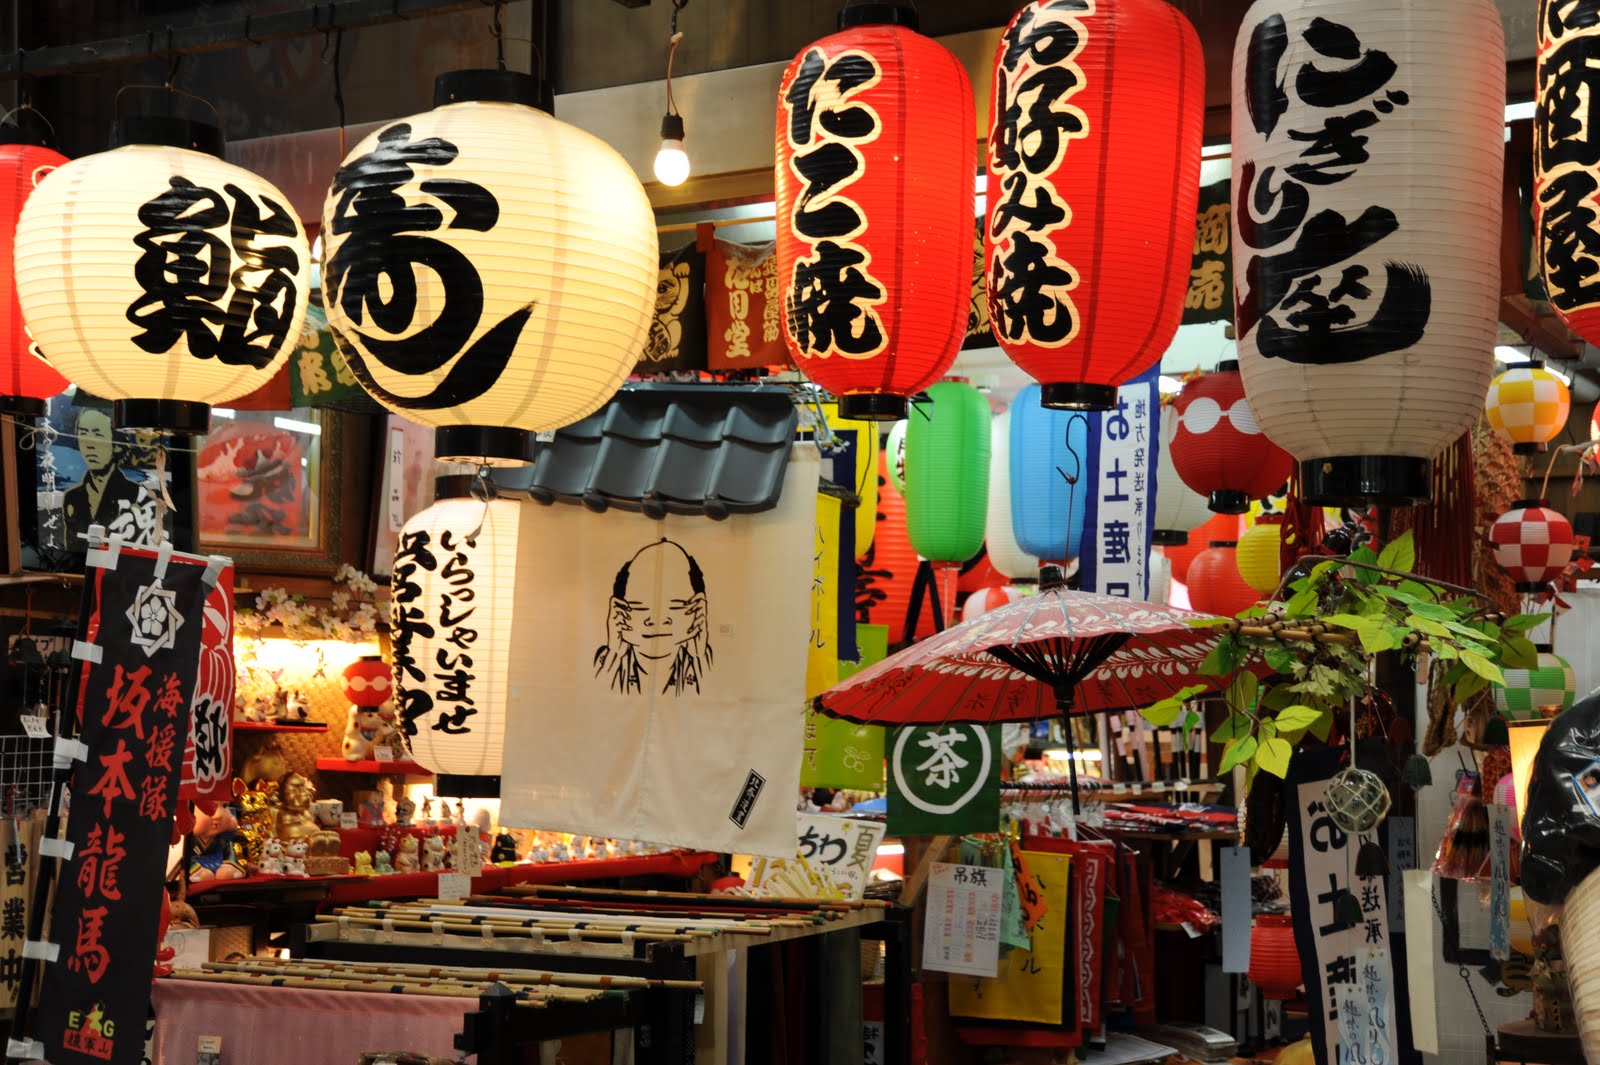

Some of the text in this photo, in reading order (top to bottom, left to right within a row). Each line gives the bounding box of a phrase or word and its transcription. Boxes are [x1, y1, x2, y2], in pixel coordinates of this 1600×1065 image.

[784, 49, 885, 355] たこ焼
[990, 0, 1091, 345] お好み焼
[431, 529, 478, 734] いらっしゃいませ
[139, 672, 184, 822] 海援隊
[916, 728, 969, 790] 茶
[67, 664, 153, 984] 坂本龍馬
[847, 825, 880, 870] 夏
[0, 842, 27, 991] 営業中
[68, 1010, 115, 1037] E G
